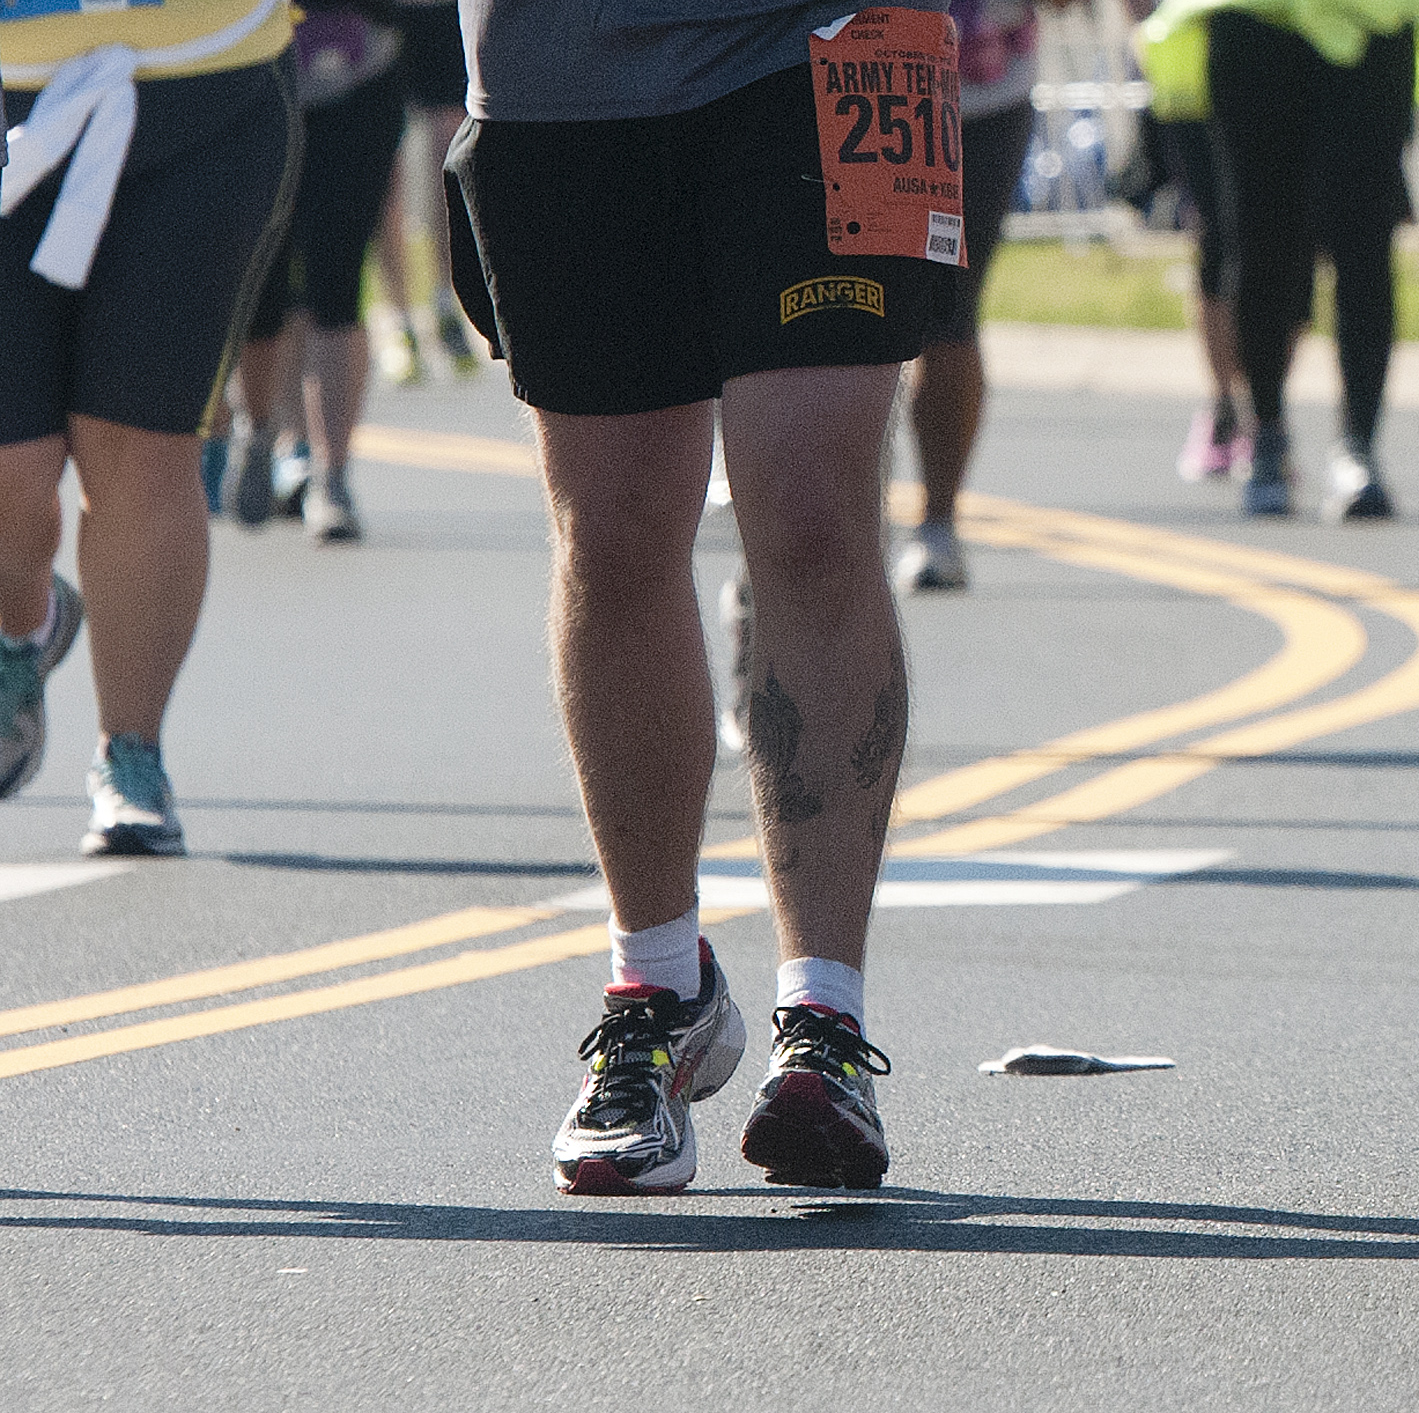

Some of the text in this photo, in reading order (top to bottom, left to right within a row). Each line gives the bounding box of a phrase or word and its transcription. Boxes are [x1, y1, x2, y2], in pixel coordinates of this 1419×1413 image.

[826, 61, 894, 94] ARMY
[835, 94, 961, 173] 2510
[894, 177, 928, 195] AUSA
[785, 283, 880, 315] RANGER
